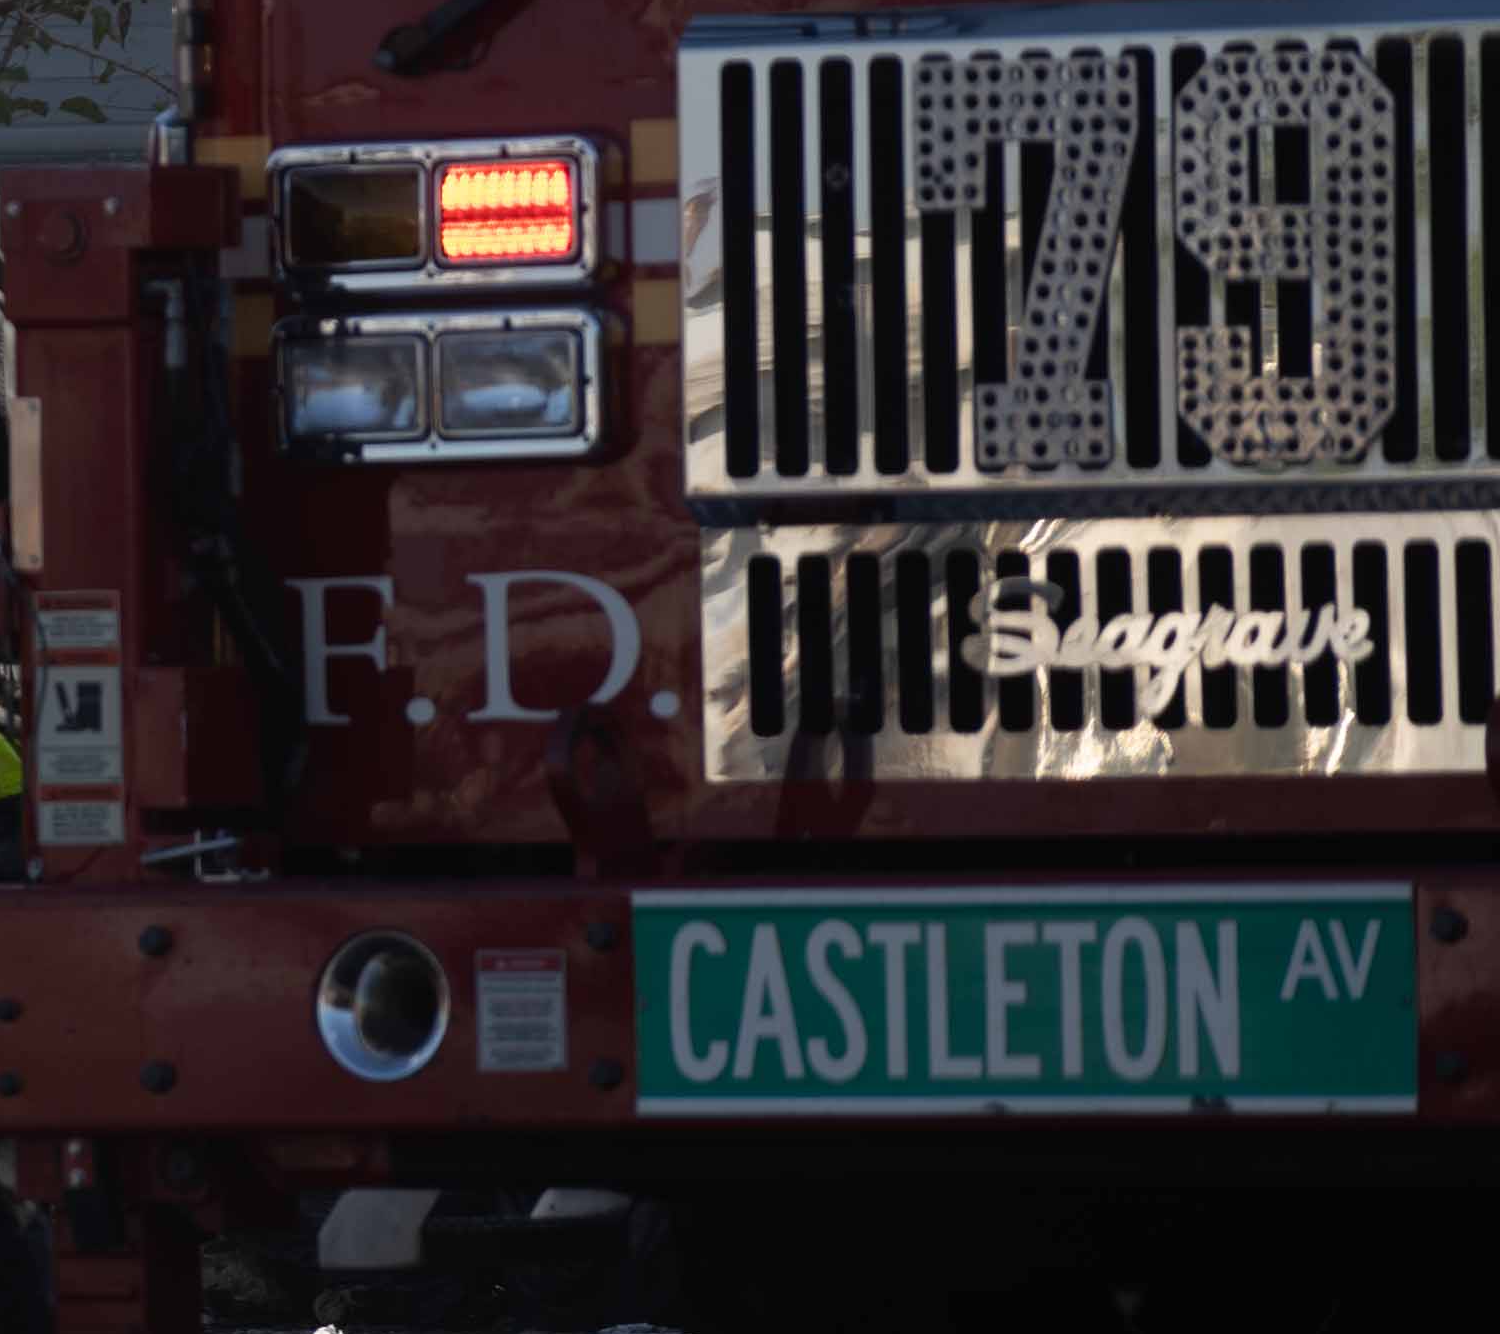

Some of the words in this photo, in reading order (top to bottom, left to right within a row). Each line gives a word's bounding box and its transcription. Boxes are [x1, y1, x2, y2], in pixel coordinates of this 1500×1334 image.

[912, 47, 1395, 470] 79
[286, 569, 680, 727] F.D.
[961, 575, 1375, 717] Seagrave
[668, 916, 1242, 1083] CASTLETON
[1280, 918, 1382, 1004] AV
